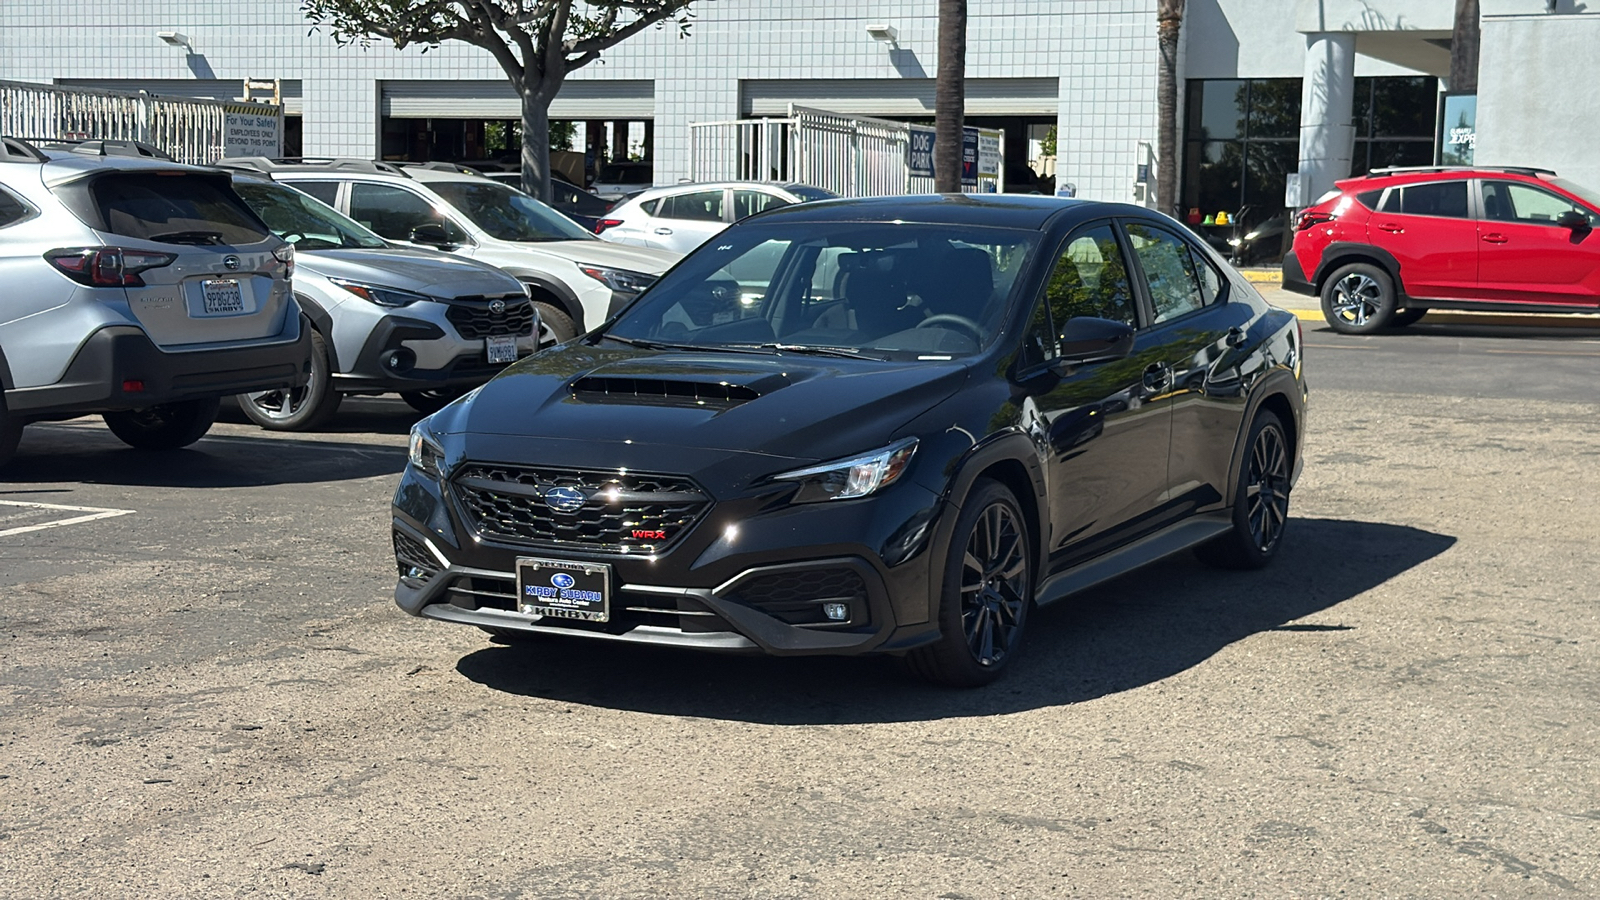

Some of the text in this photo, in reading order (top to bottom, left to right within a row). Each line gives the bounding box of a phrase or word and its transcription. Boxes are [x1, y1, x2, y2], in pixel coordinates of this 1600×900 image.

[226, 115, 276, 130] For Your Safety
[230, 128, 260, 138] EMPLOYEES
[228, 137, 249, 145] BEYOND
[913, 134, 929, 151] DOG
[911, 152, 930, 169] PARK
[207, 291, 241, 307] 9PBG238
[631, 530, 666, 539] WRX
[525, 585, 602, 602] KIRBY SUBARU
[535, 607, 592, 620] KIRBY
